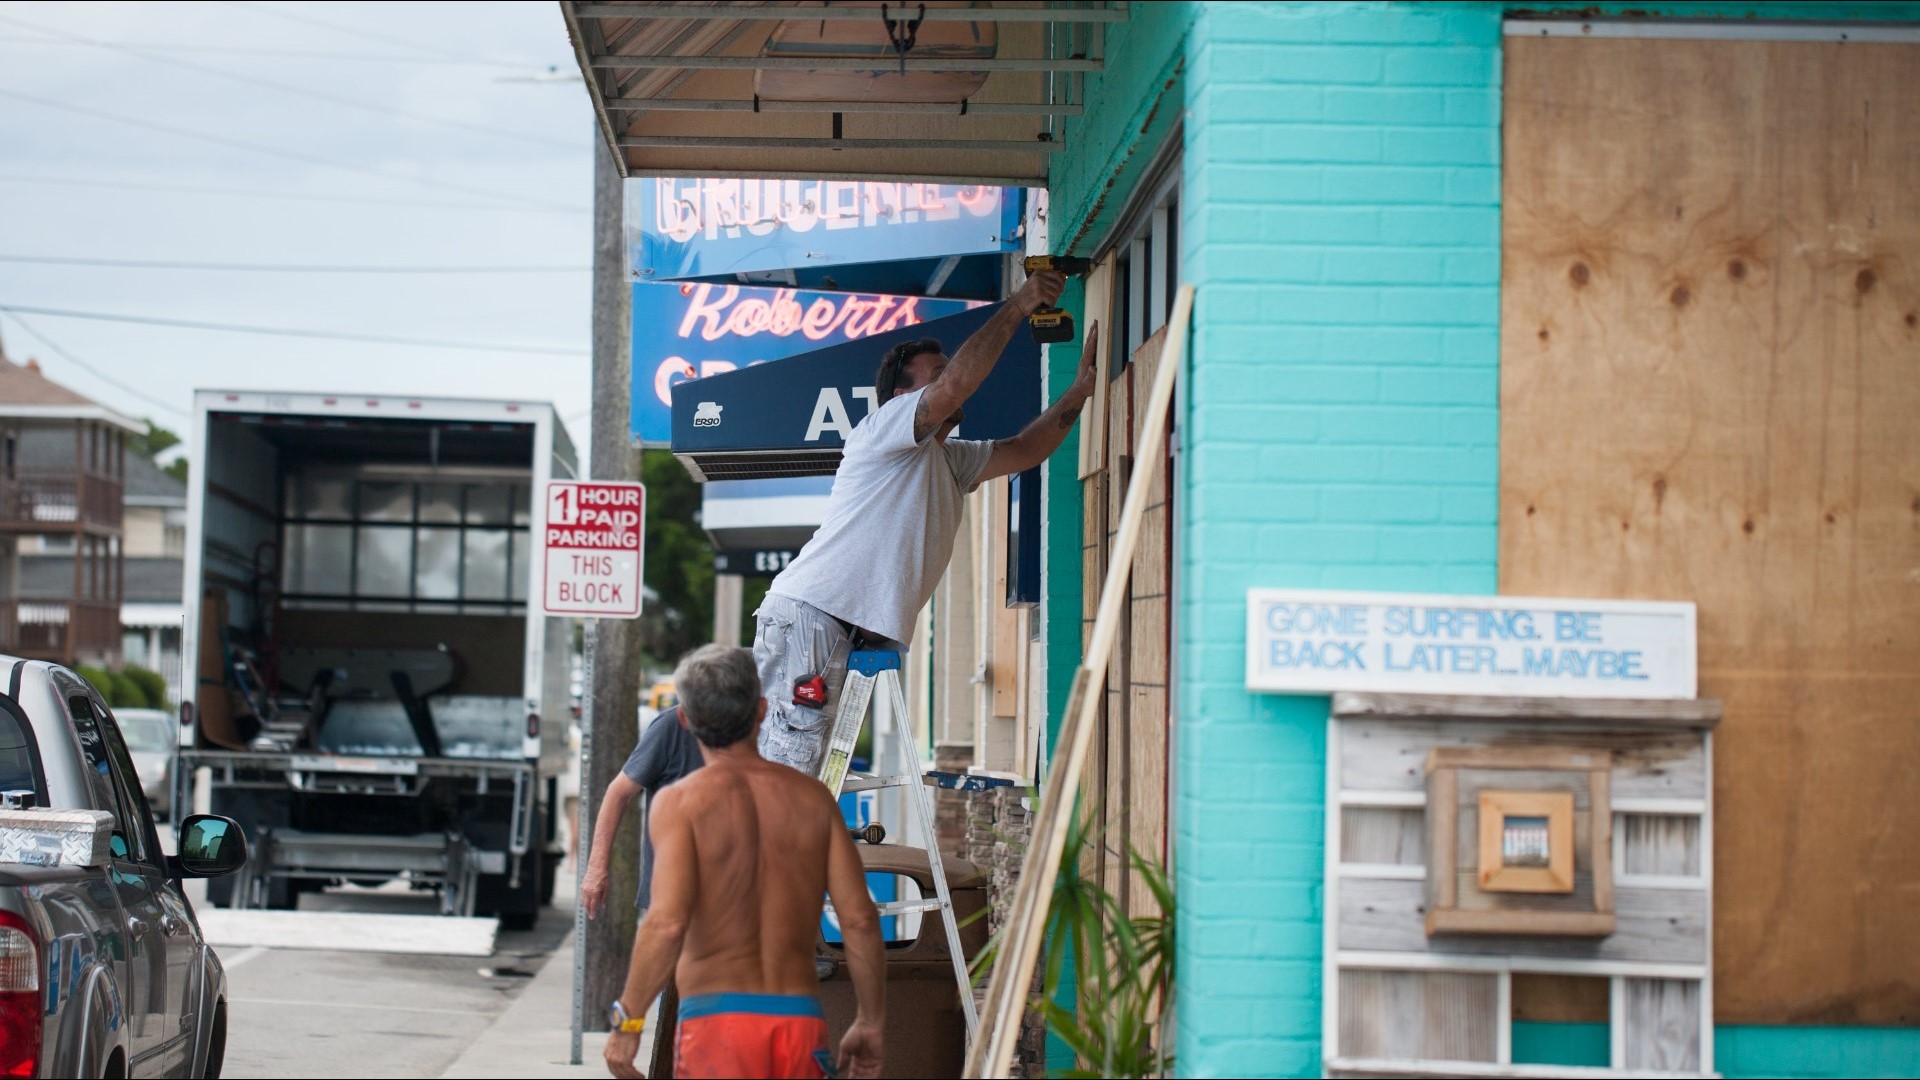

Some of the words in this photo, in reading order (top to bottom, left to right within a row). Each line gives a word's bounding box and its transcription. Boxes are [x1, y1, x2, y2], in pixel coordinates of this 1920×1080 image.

[678, 283, 924, 342] Roberts
[580, 488, 639, 506] HOUR
[581, 509, 639, 527] PAID
[547, 529, 638, 548] PARKING
[571, 555, 613, 576] THIS
[559, 582, 623, 603] BLOCK
[1267, 605, 1369, 635] GONE
[1384, 607, 1542, 640] SURFING.
[1555, 611, 1603, 642] BE
[1270, 639, 1367, 671] BACK
